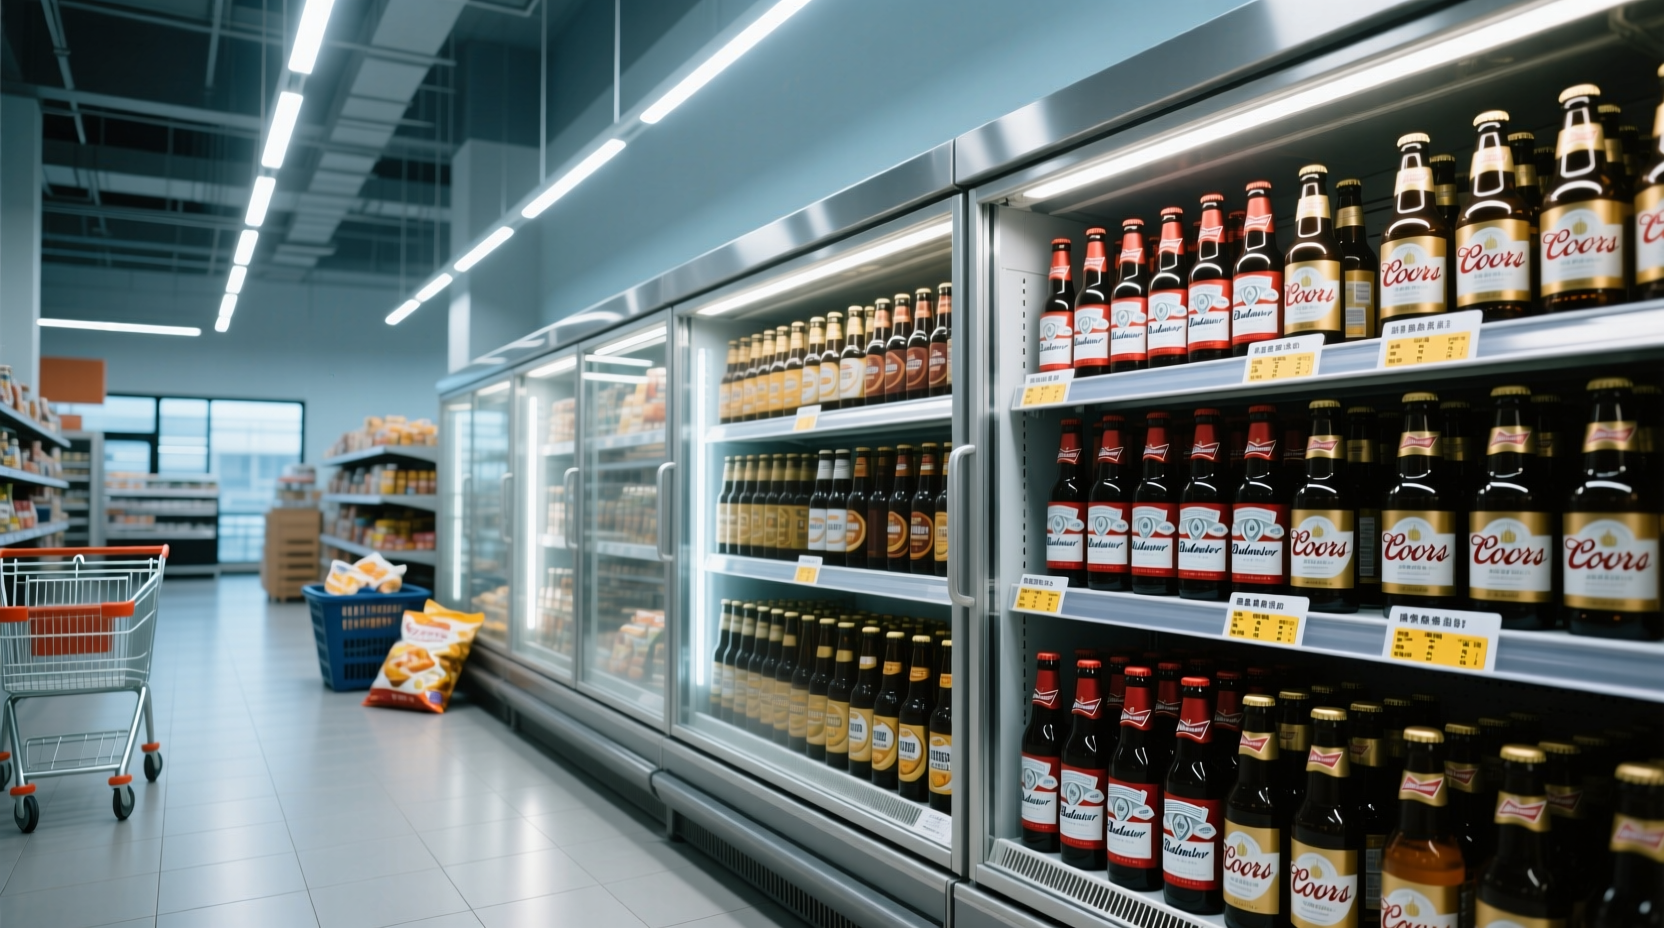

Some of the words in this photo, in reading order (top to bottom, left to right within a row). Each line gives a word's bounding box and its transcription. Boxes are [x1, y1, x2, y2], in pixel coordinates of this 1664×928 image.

[1457, 244, 1526, 274] Coors
[1542, 229, 1620, 261] Coors
[1382, 259, 1441, 287] Coors
[1290, 530, 1350, 558] Coors
[1382, 533, 1450, 562] Coors
[1471, 534, 1547, 566] Coors
[1564, 538, 1651, 571] Coors
[1223, 839, 1274, 880] Coors
[1291, 863, 1352, 903] Coors
